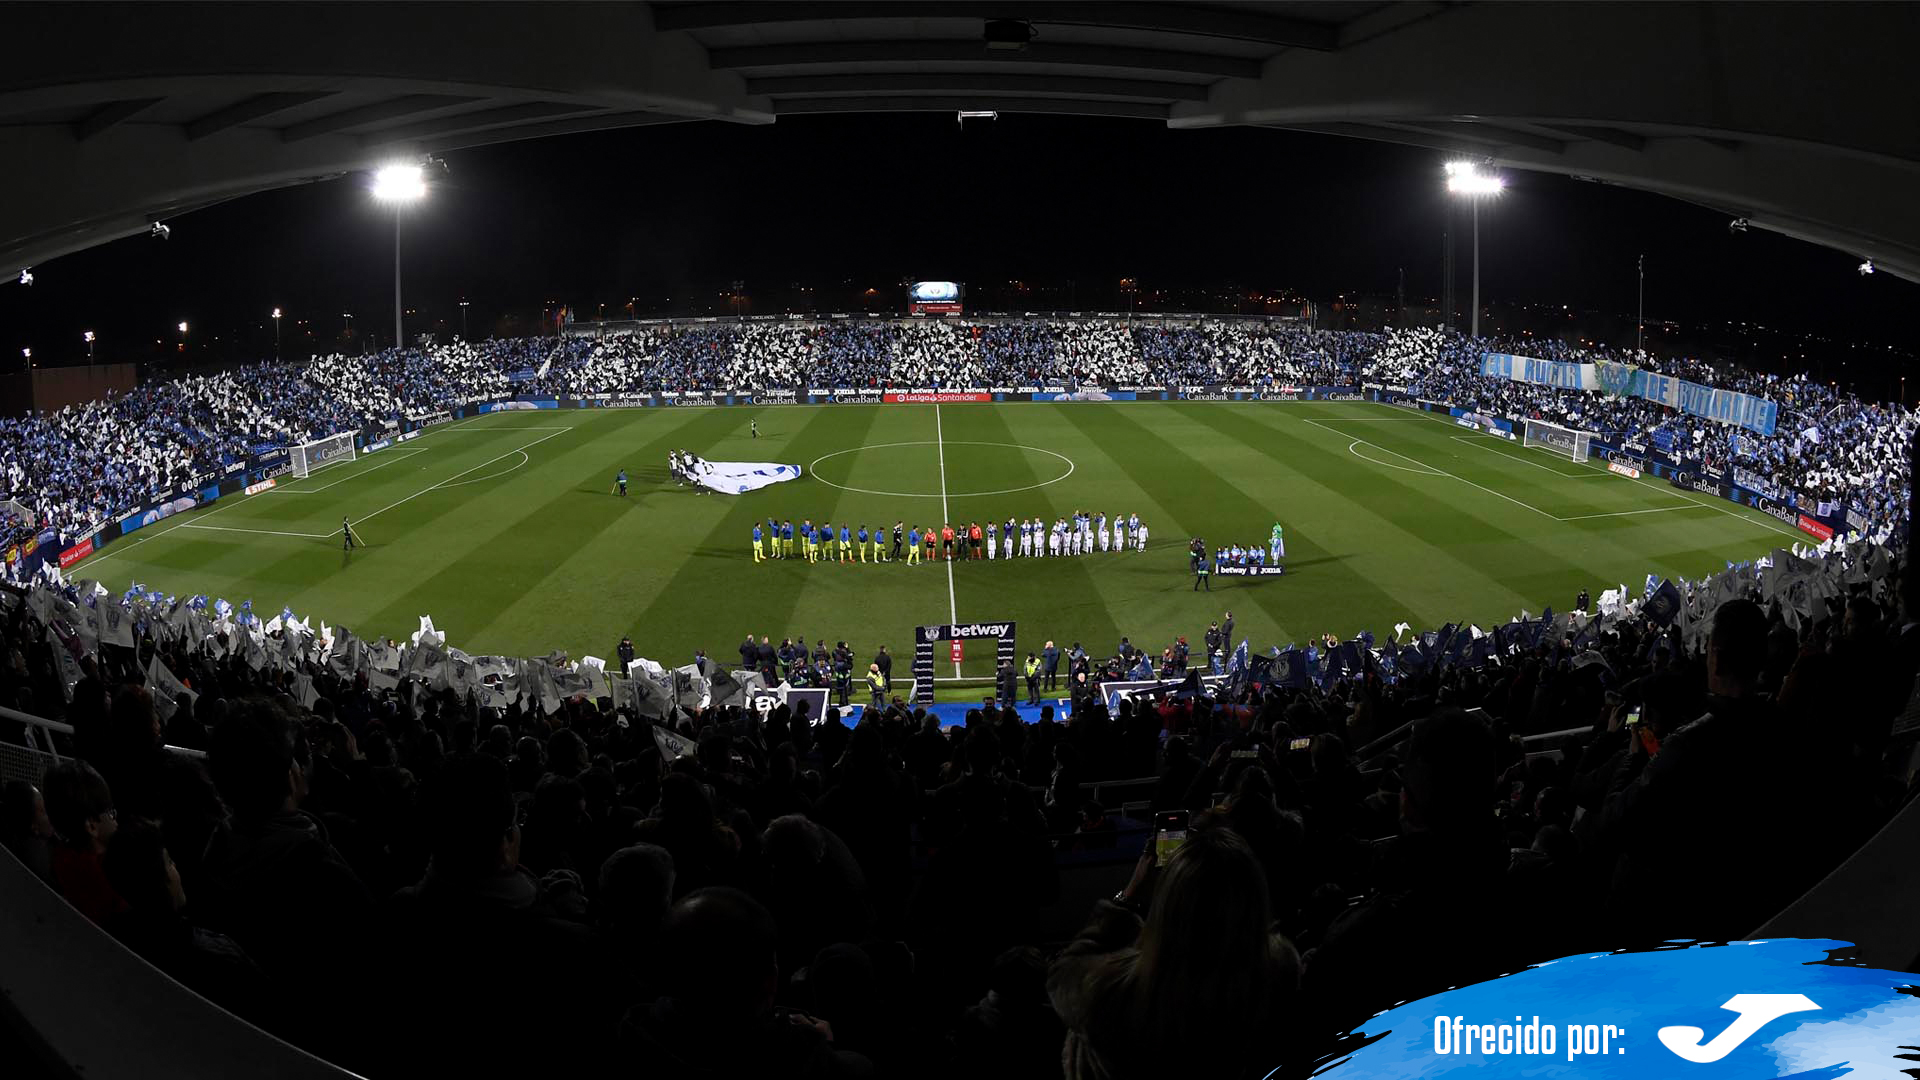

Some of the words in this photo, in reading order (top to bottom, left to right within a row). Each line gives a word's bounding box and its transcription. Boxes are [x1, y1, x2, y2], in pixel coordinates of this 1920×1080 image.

[884, 387, 909, 395] betway
[911, 387, 936, 395] betway
[937, 387, 962, 395] betway
[1386, 385, 1408, 394] betway
[753, 395, 798, 405] CaixaBank
[836, 393, 881, 404] CaixaBank
[938, 394, 978, 402] Santander
[1186, 391, 1229, 401] CaixaBank
[1260, 391, 1299, 401] CaixaBank
[1329, 391, 1365, 401] CaixaBank
[602, 398, 642, 408] CaixaBank
[674, 397, 717, 408] CaixaBank
[1607, 450, 1646, 472] CaixaBank
[1611, 464, 1634, 478] STIHL
[1759, 497, 1798, 528] CaixaBank
[1220, 566, 1247, 576] betway
[950, 624, 1010, 639] betway
